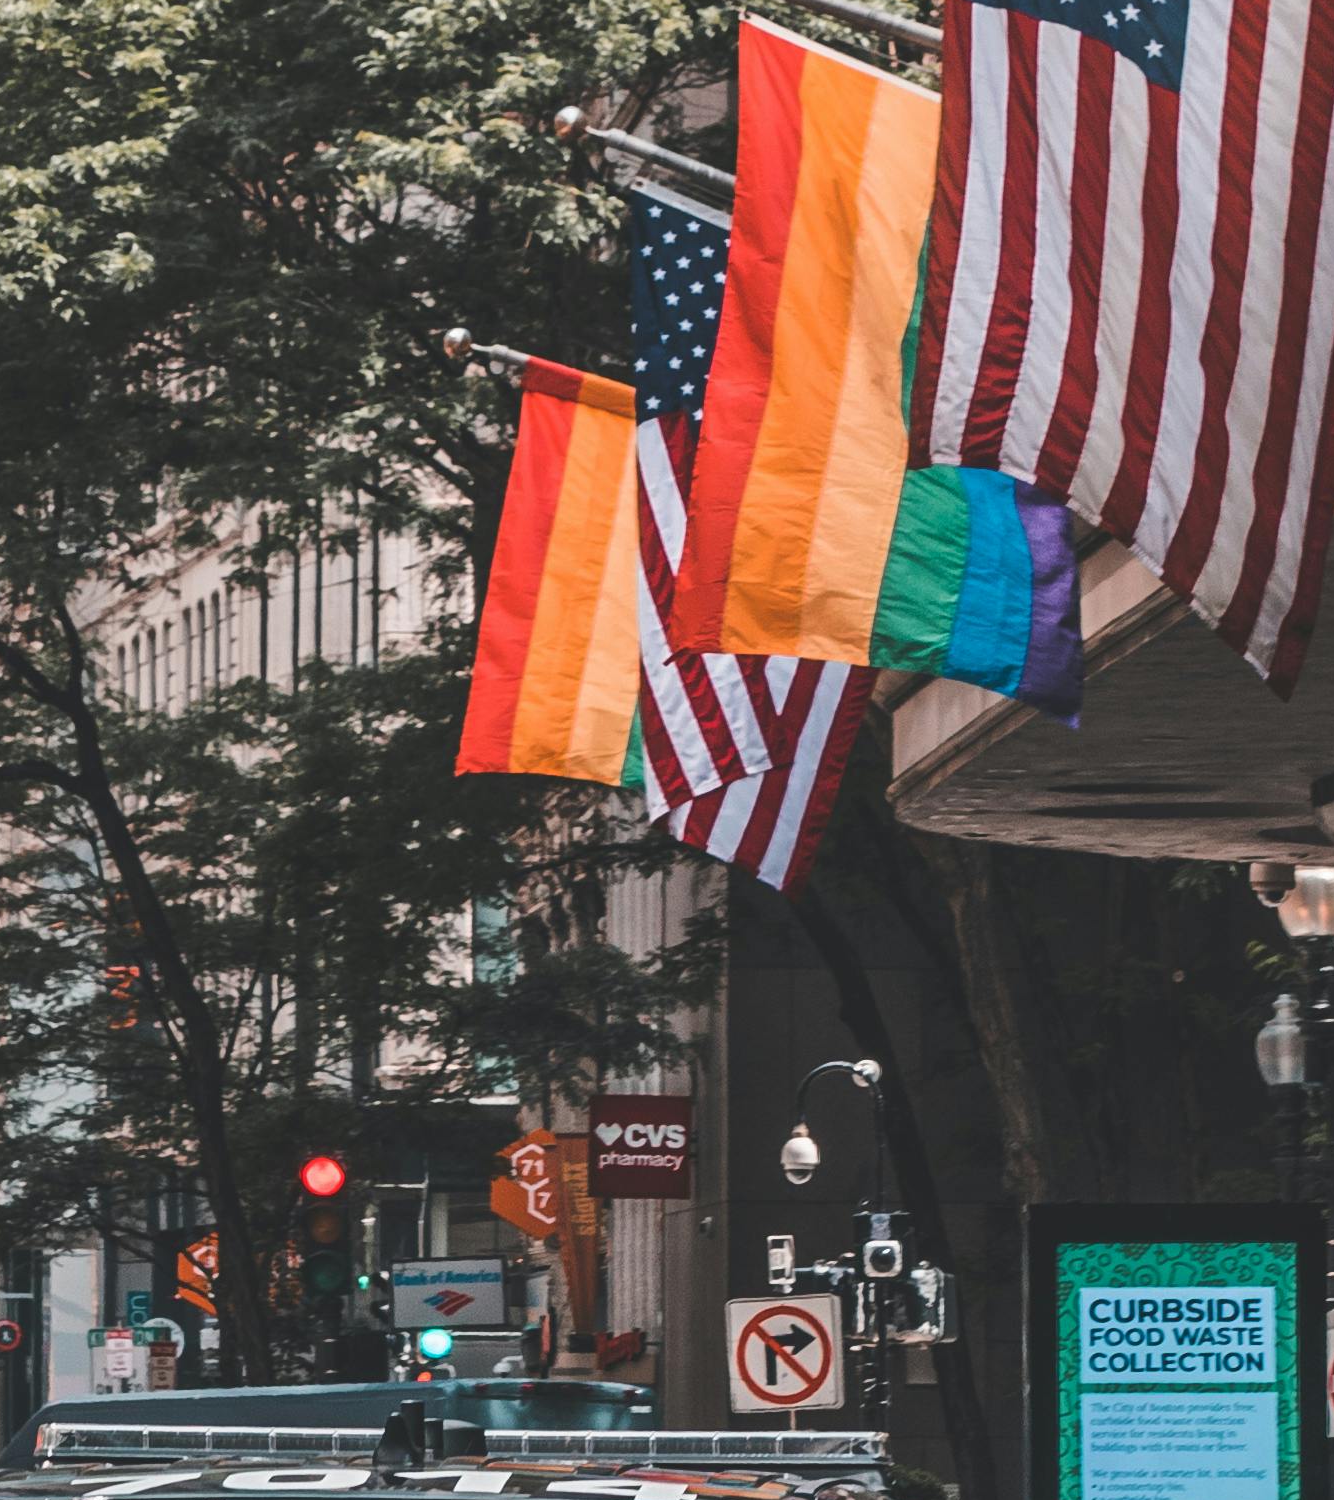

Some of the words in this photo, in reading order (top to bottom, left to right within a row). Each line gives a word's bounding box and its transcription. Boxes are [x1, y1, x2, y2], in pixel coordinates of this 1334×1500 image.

[624, 1123, 686, 1148] CVS
[598, 1152, 685, 1170] pharmacy
[393, 1272, 427, 1286] Bank
[430, 1271, 445, 1284] of
[447, 1271, 501, 1284] America
[1089, 1298, 1263, 1323] CURBSIDE
[1089, 1327, 1165, 1346] FOOD
[1172, 1327, 1264, 1346] WASTE
[1089, 1352, 1264, 1373] COLLECTION
